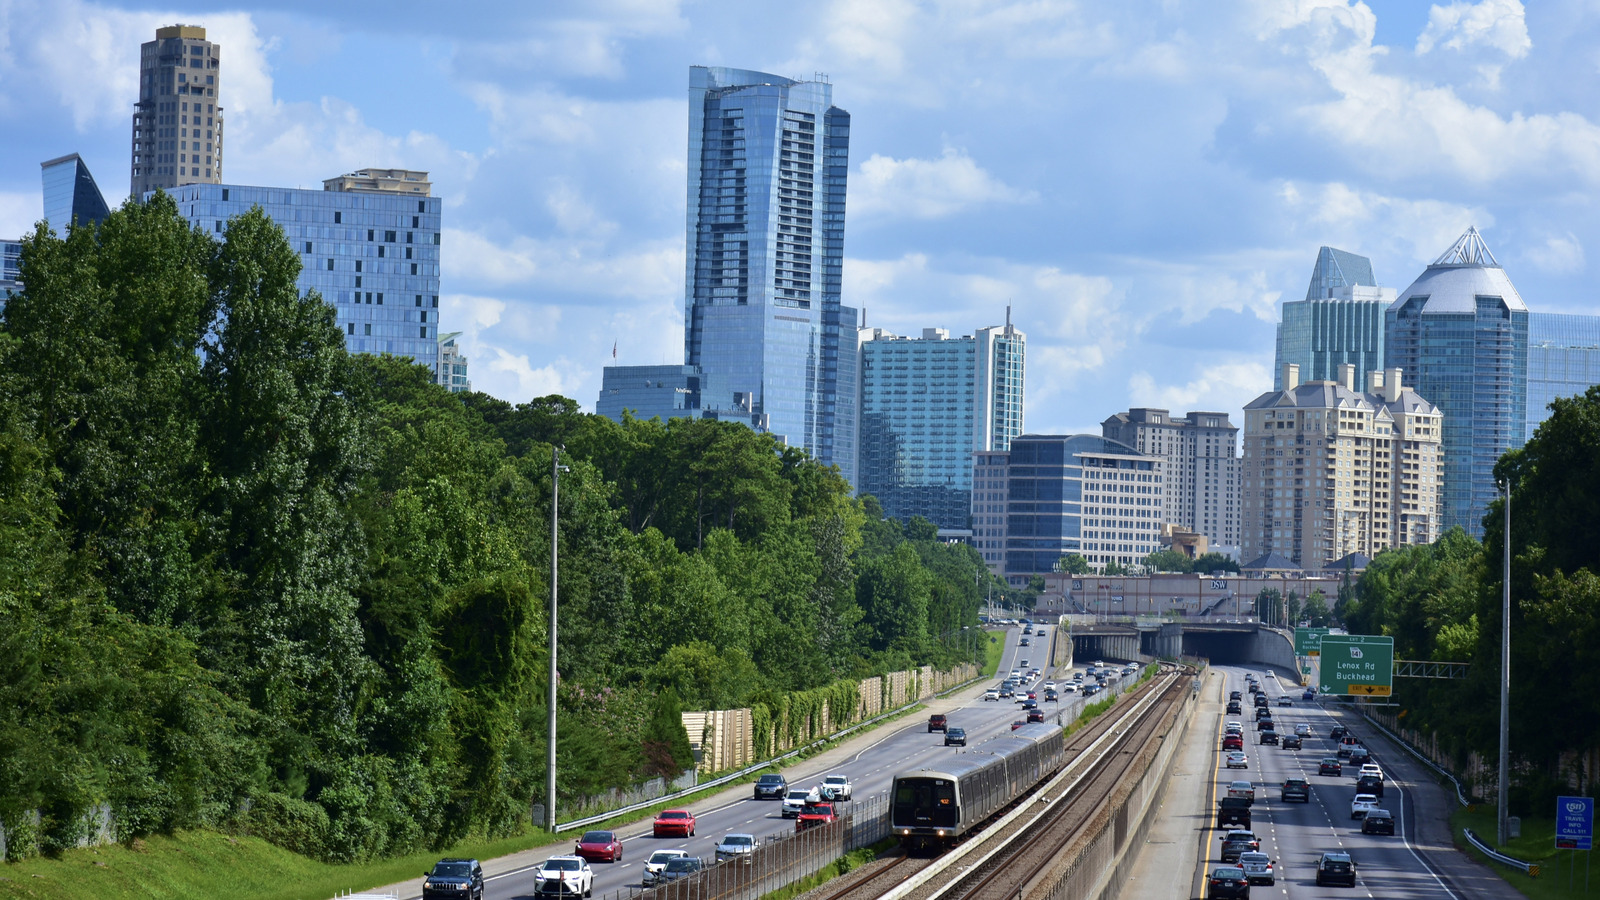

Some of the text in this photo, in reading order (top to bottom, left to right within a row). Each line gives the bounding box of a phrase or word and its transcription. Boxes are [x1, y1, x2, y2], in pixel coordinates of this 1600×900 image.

[1210, 580, 1226, 590] DSW
[1337, 661, 1375, 670] Lenox Rd
[1336, 672, 1375, 681] Buckhead
